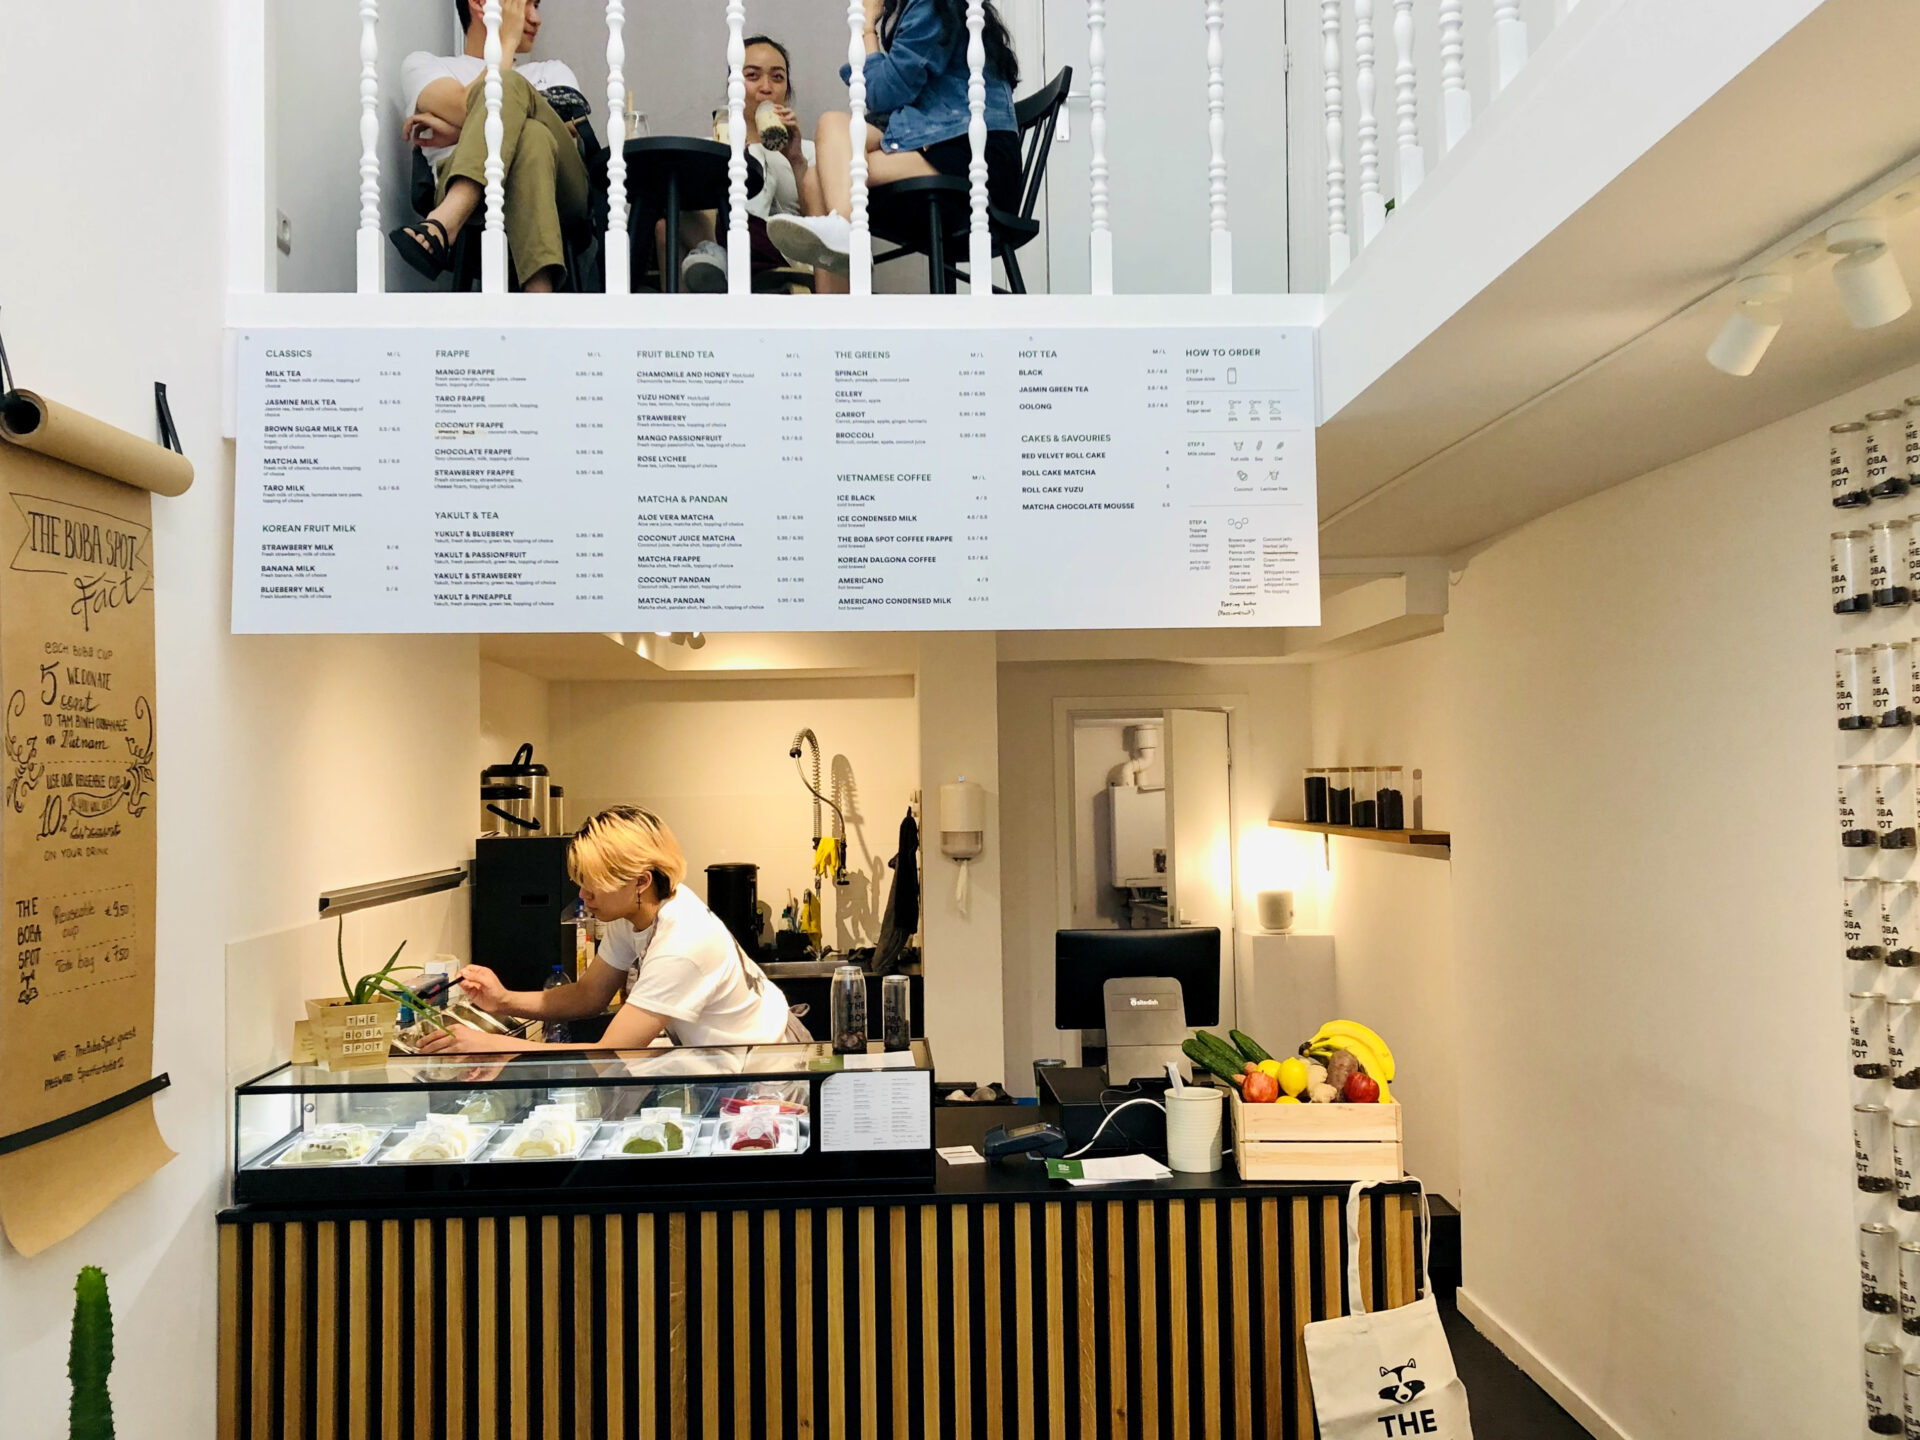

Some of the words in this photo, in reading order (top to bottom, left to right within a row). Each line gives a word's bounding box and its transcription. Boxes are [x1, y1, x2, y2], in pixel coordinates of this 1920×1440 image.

[28, 512, 60, 555] THE
[64, 519, 103, 564] BOBA
[106, 530, 137, 570] SPOT
[71, 572, 145, 632] Fact
[40, 660, 60, 705] 5
[66, 667, 81, 685] WE
[43, 714, 52, 726] TO
[57, 714, 74, 728] TAM
[16, 897, 39, 918] THE
[17, 924, 42, 946] BOBA
[18, 947, 41, 969] SPOT
[348, 1016, 375, 1024] THE
[345, 1030, 382, 1038] BOBA
[345, 1043, 380, 1052] SPOT
[1378, 1409, 1438, 1438] THE
